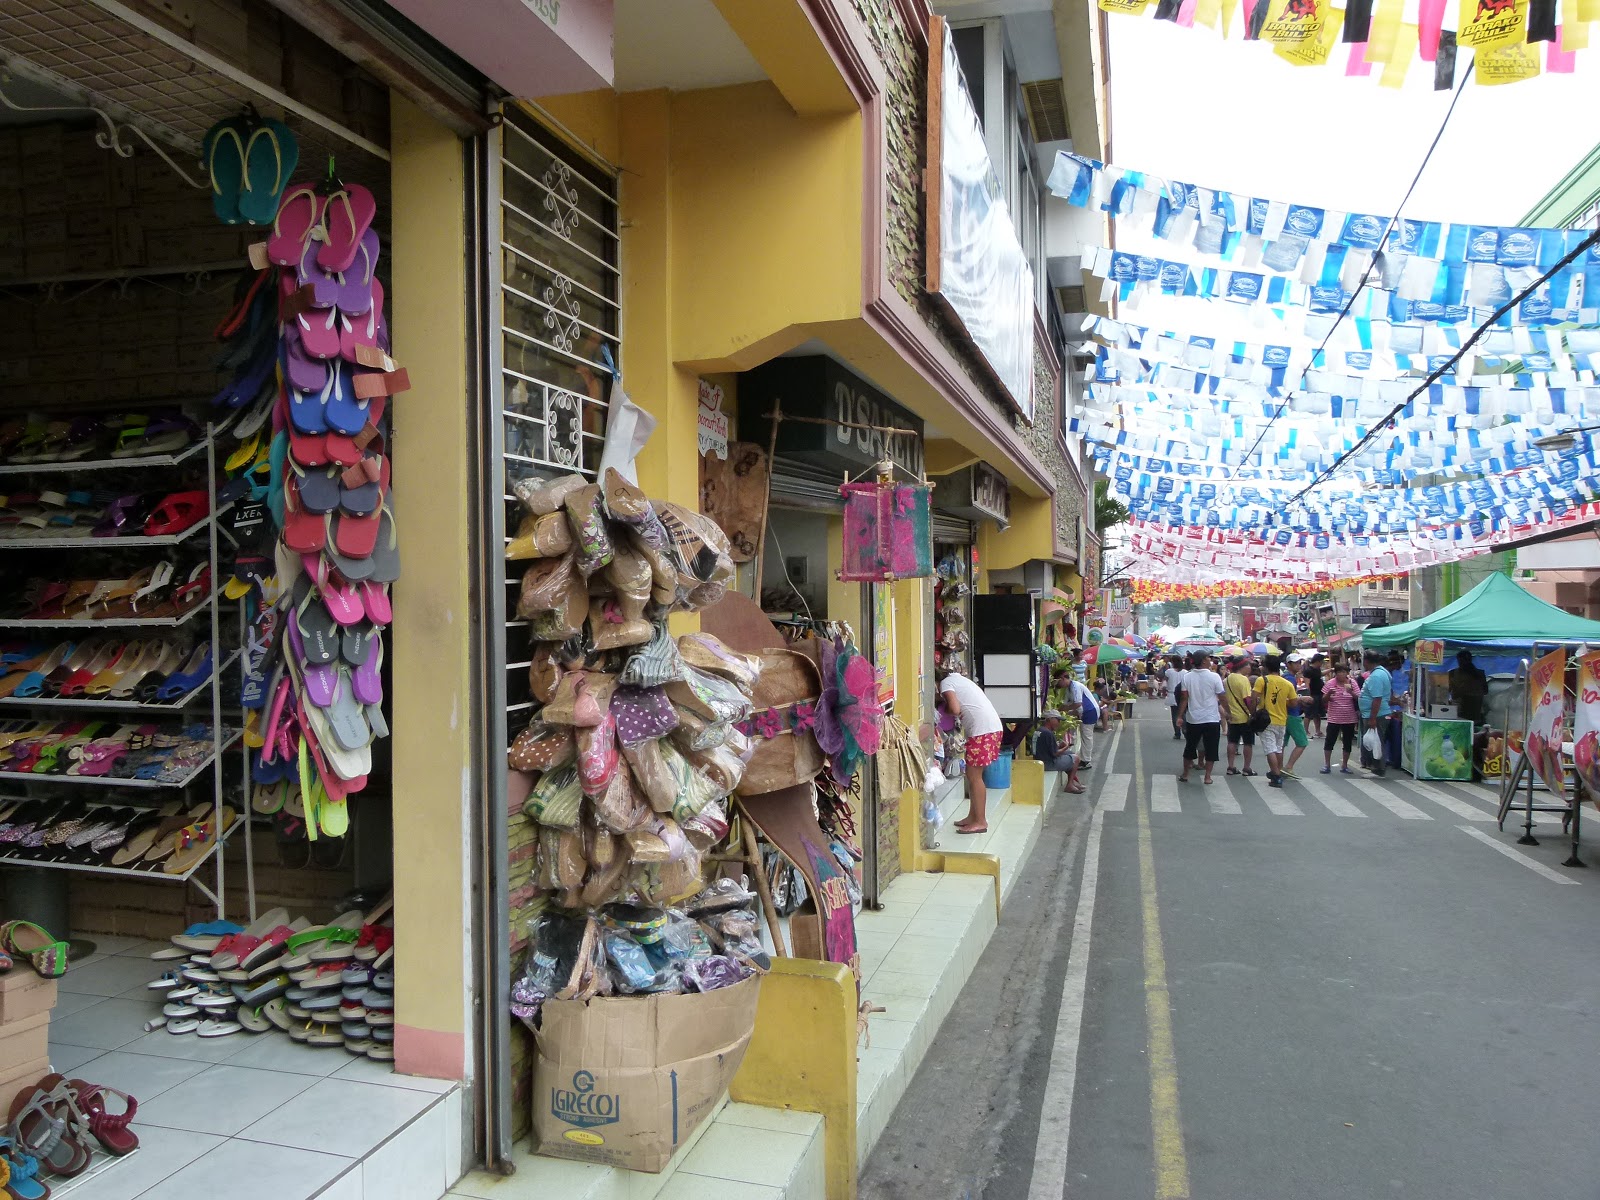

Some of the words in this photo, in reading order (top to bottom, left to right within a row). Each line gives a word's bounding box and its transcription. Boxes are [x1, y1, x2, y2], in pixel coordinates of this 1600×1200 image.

[1265, 22, 1321, 31] BARAKO
[1461, 15, 1523, 38] BARAKO
[1272, 30, 1313, 38] BULL
[1471, 27, 1516, 42] BULL
[555, 1089, 613, 1117] GRECO
[560, 1113, 580, 1122] STRONG
[582, 1114, 608, 1124] ADHESIVE
